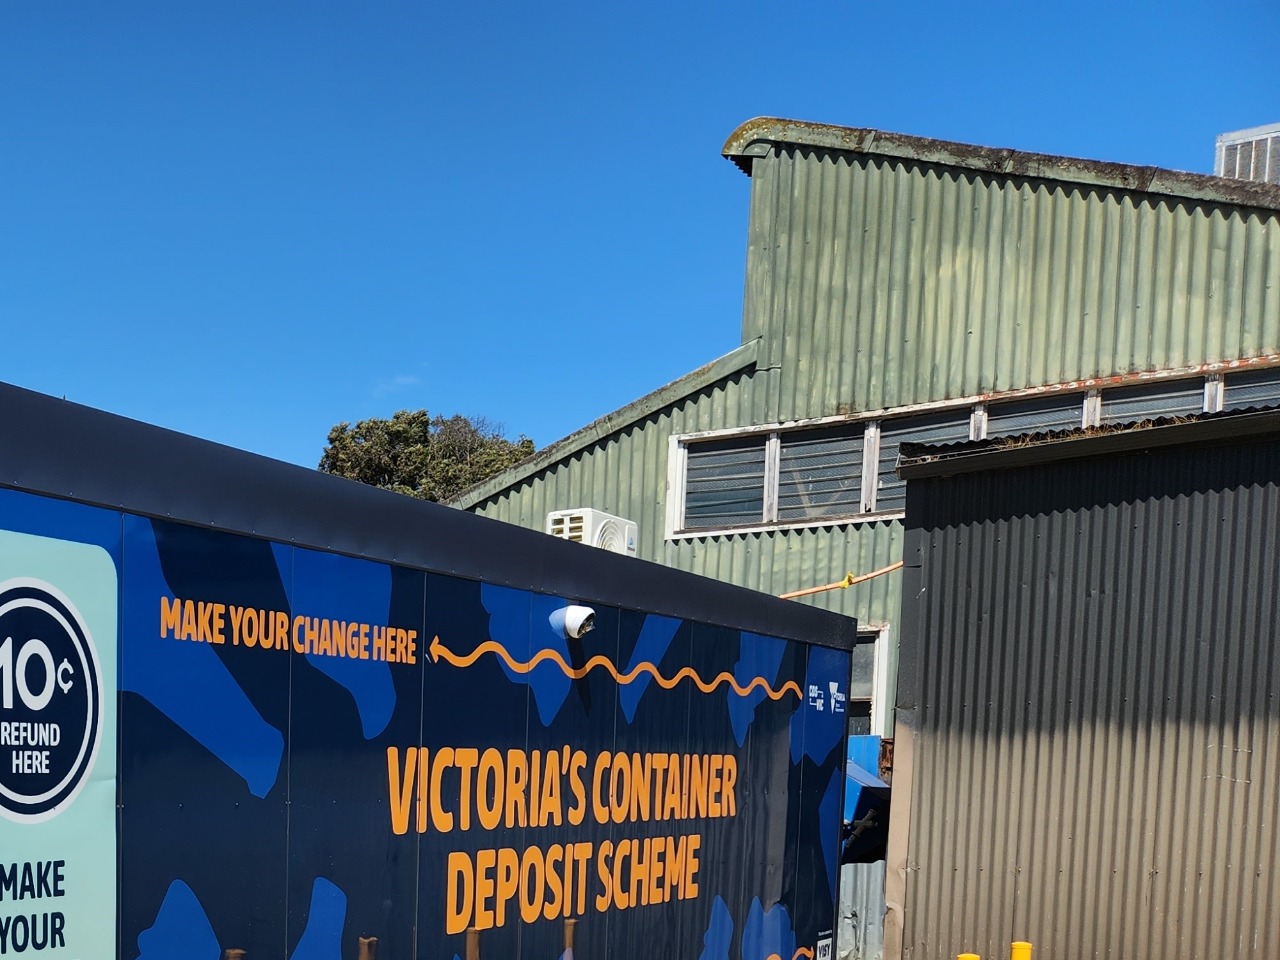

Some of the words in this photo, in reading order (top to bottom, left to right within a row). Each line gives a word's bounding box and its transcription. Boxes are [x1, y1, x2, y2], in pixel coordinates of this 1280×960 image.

[160, 596, 225, 645] MAKE
[229, 604, 289, 650] YOUR
[292, 615, 369, 660] CHANGE
[372, 625, 417, 664] HERE
[0, 721, 61, 747] REFUND
[12, 750, 50, 774] HERE
[386, 744, 588, 835] VICTORIA'S
[592, 750, 738, 825] CONTAINER
[446, 841, 593, 935] DEPOSIT
[595, 834, 701, 913] SCHEME
